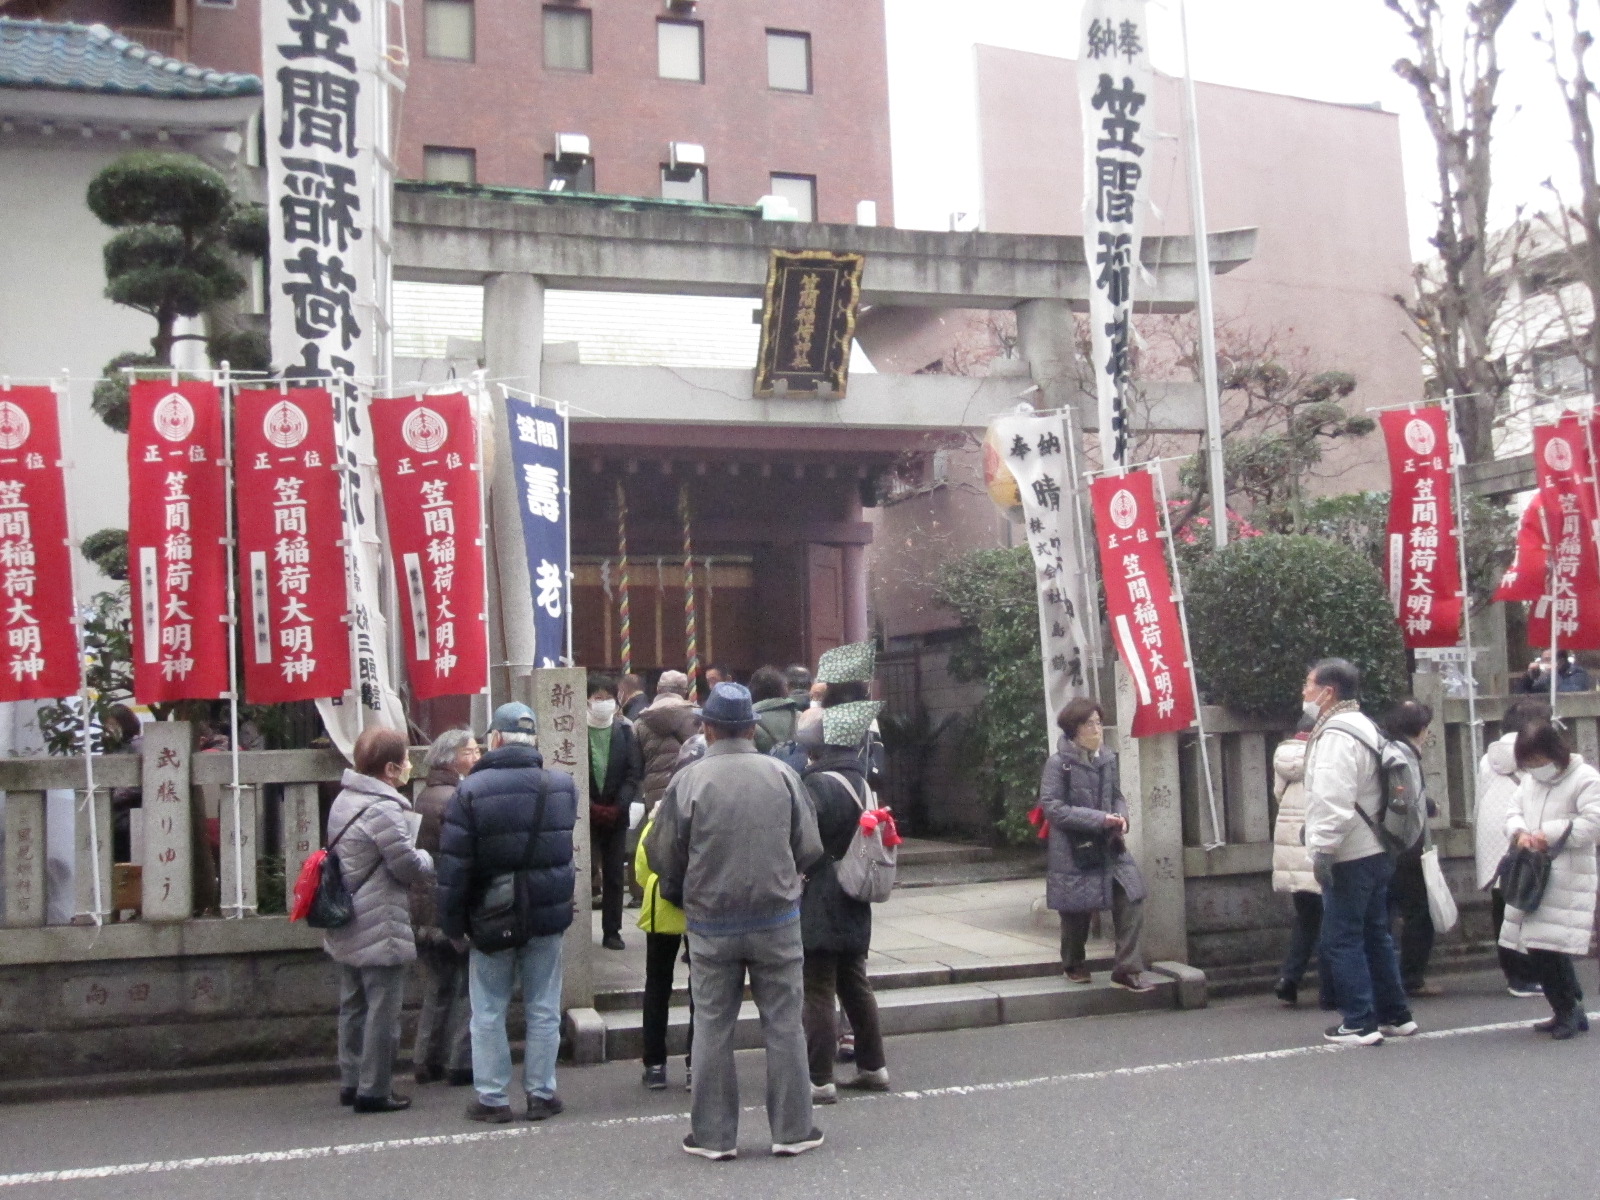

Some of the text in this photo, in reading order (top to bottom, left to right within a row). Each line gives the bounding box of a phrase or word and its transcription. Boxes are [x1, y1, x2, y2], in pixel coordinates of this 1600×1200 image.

[143, 445, 207, 463] 正一位
[253, 451, 322, 470] 正一位
[397, 452, 462, 475] 正一位
[516, 414, 558, 450] 笠間
[1010, 431, 1062, 459] 奉納
[1404, 456, 1443, 473] 正一位
[0, 481, 45, 682] 笠間稲荷大明神
[162, 471, 194, 682] 笠間稲荷大明神
[273, 477, 317, 683] 笠間稲荷大明神
[420, 479, 458, 678] 笠間稲荷大明神
[523, 463, 562, 668] 壽老
[1109, 529, 1151, 549] 正一位
[1405, 478, 1439, 636] 笠間稲荷大明神
[1122, 554, 1175, 719] 笠間稲荷大明神
[551, 683, 577, 777] 新田建
[155, 747, 181, 902] 武藤りゆう
